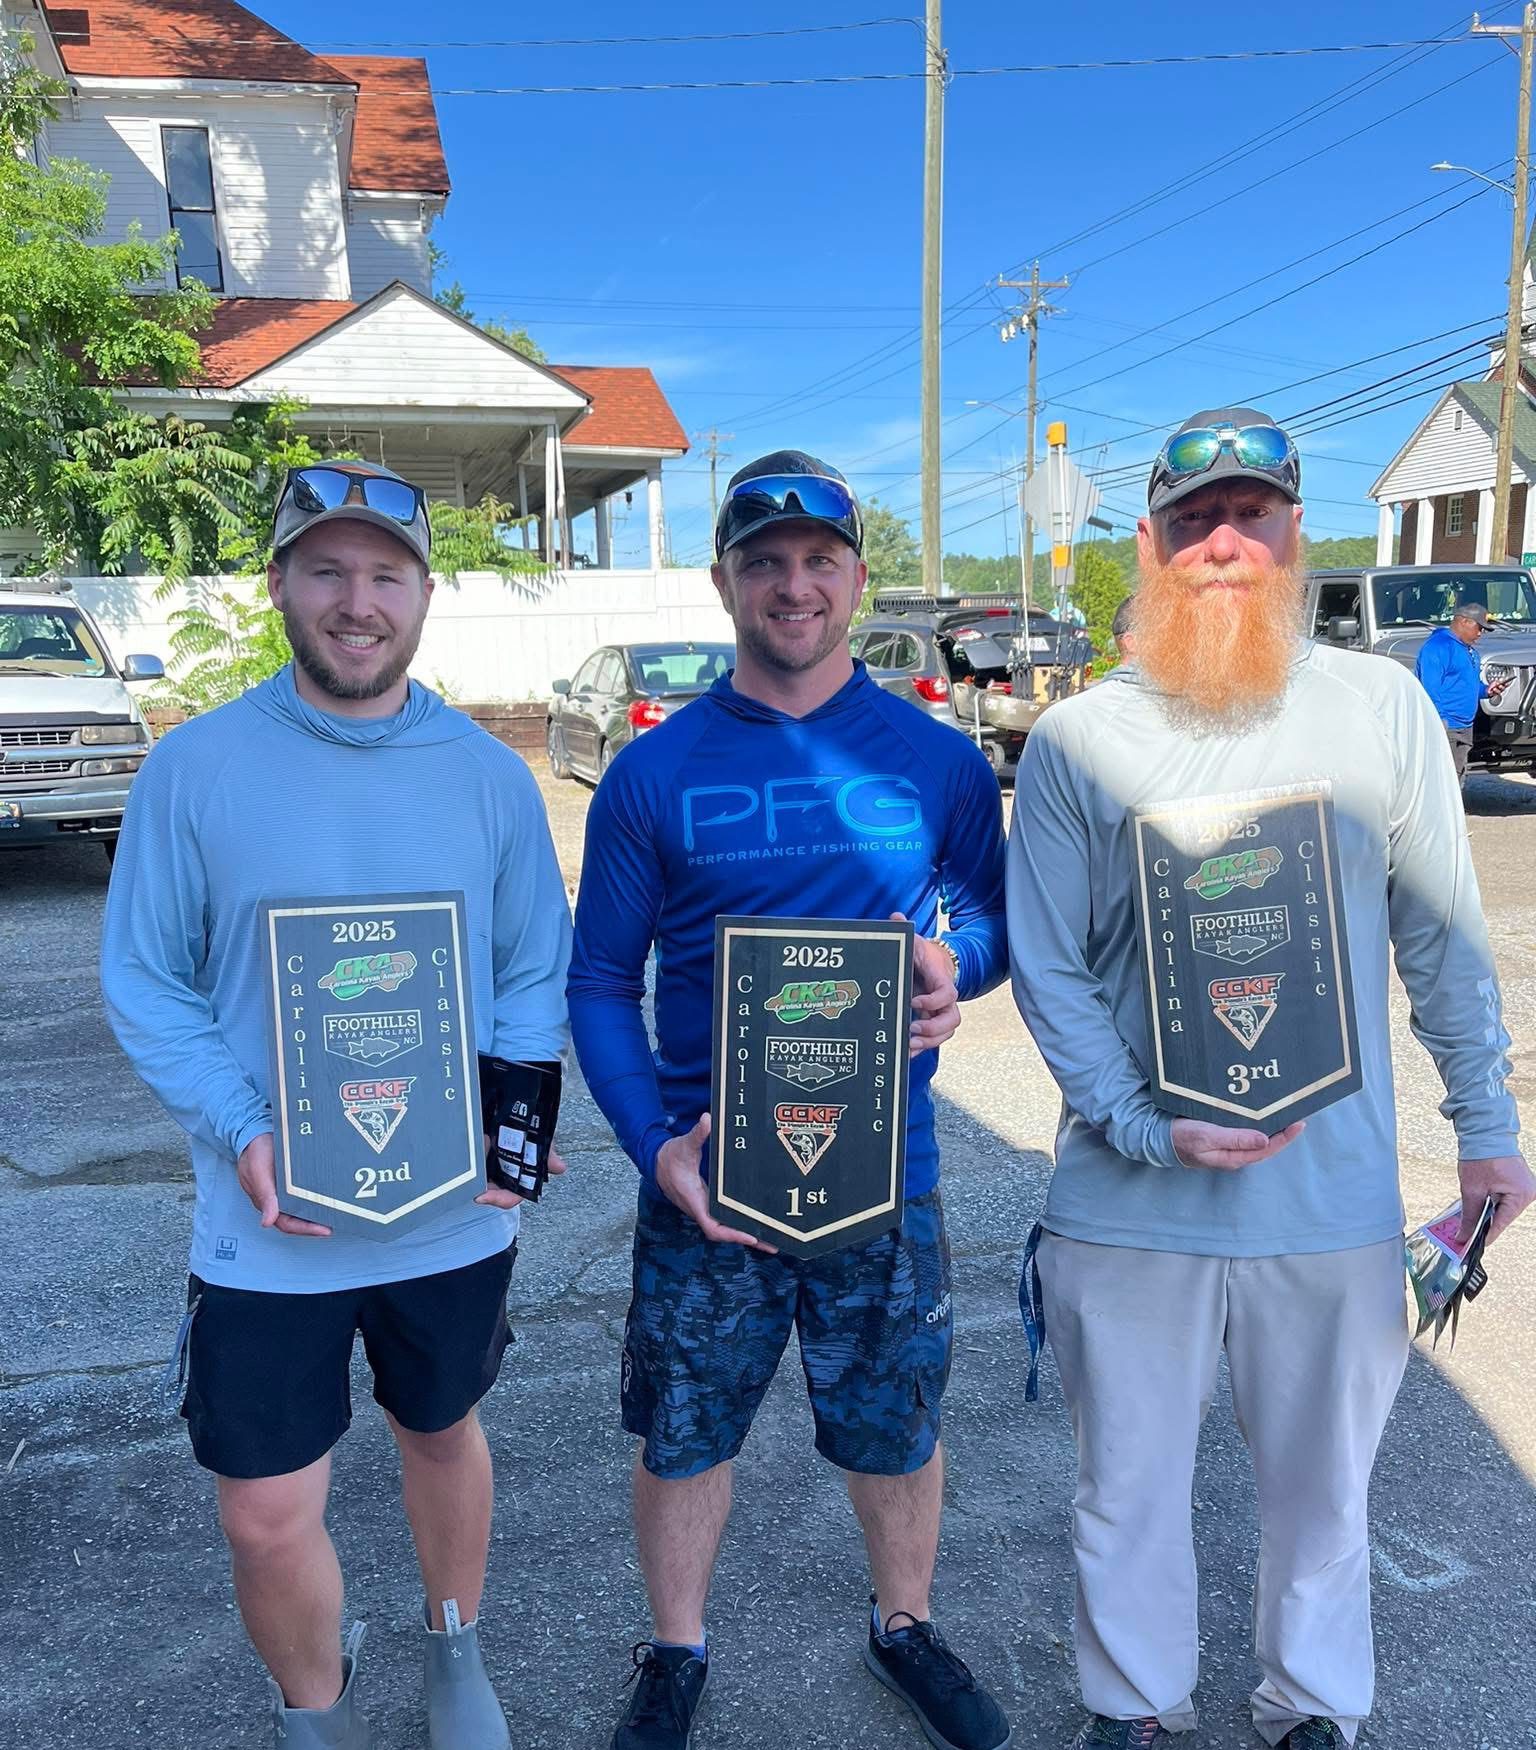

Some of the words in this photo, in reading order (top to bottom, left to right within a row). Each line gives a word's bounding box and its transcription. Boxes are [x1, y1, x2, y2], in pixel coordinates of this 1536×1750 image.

[682, 774, 922, 852] PFG
[1199, 817, 1261, 842] 2025
[687, 846, 806, 866] PERFORMANCE
[812, 841, 880, 854] FISHING
[885, 840, 923, 851] GEAR
[1202, 852, 1257, 880] CKA
[332, 920, 397, 943] 2025
[1194, 910, 1285, 932] FOOTHILLS
[1196, 929, 1233, 939] KAYAK
[1237, 923, 1286, 935] ANGLERS
[1153, 858, 1184, 1033] Carolina
[1270, 932, 1285, 941] NC
[336, 954, 392, 980] CKA
[782, 946, 844, 968] 2025
[783, 982, 837, 1005] CKA
[1211, 977, 1278, 998] CCKF
[327, 1015, 417, 1032] FOOTHILLS
[329, 1031, 365, 1040] KAYAK
[370, 1028, 417, 1037] ANGLERS
[287, 955, 313, 1135] Carolina
[403, 1037, 417, 1045] NC
[769, 1042, 854, 1056] FOOTHILLS
[735, 975, 753, 1149] Carolina
[809, 1055, 854, 1063] ANGLERS
[838, 1065, 852, 1073] NC
[1227, 1059, 1281, 1095] 3rd
[343, 1080, 409, 1100] CCKF
[777, 1105, 841, 1122] CCKF
[355, 1161, 412, 1199] 2nd
[786, 1187, 828, 1216] 1st
